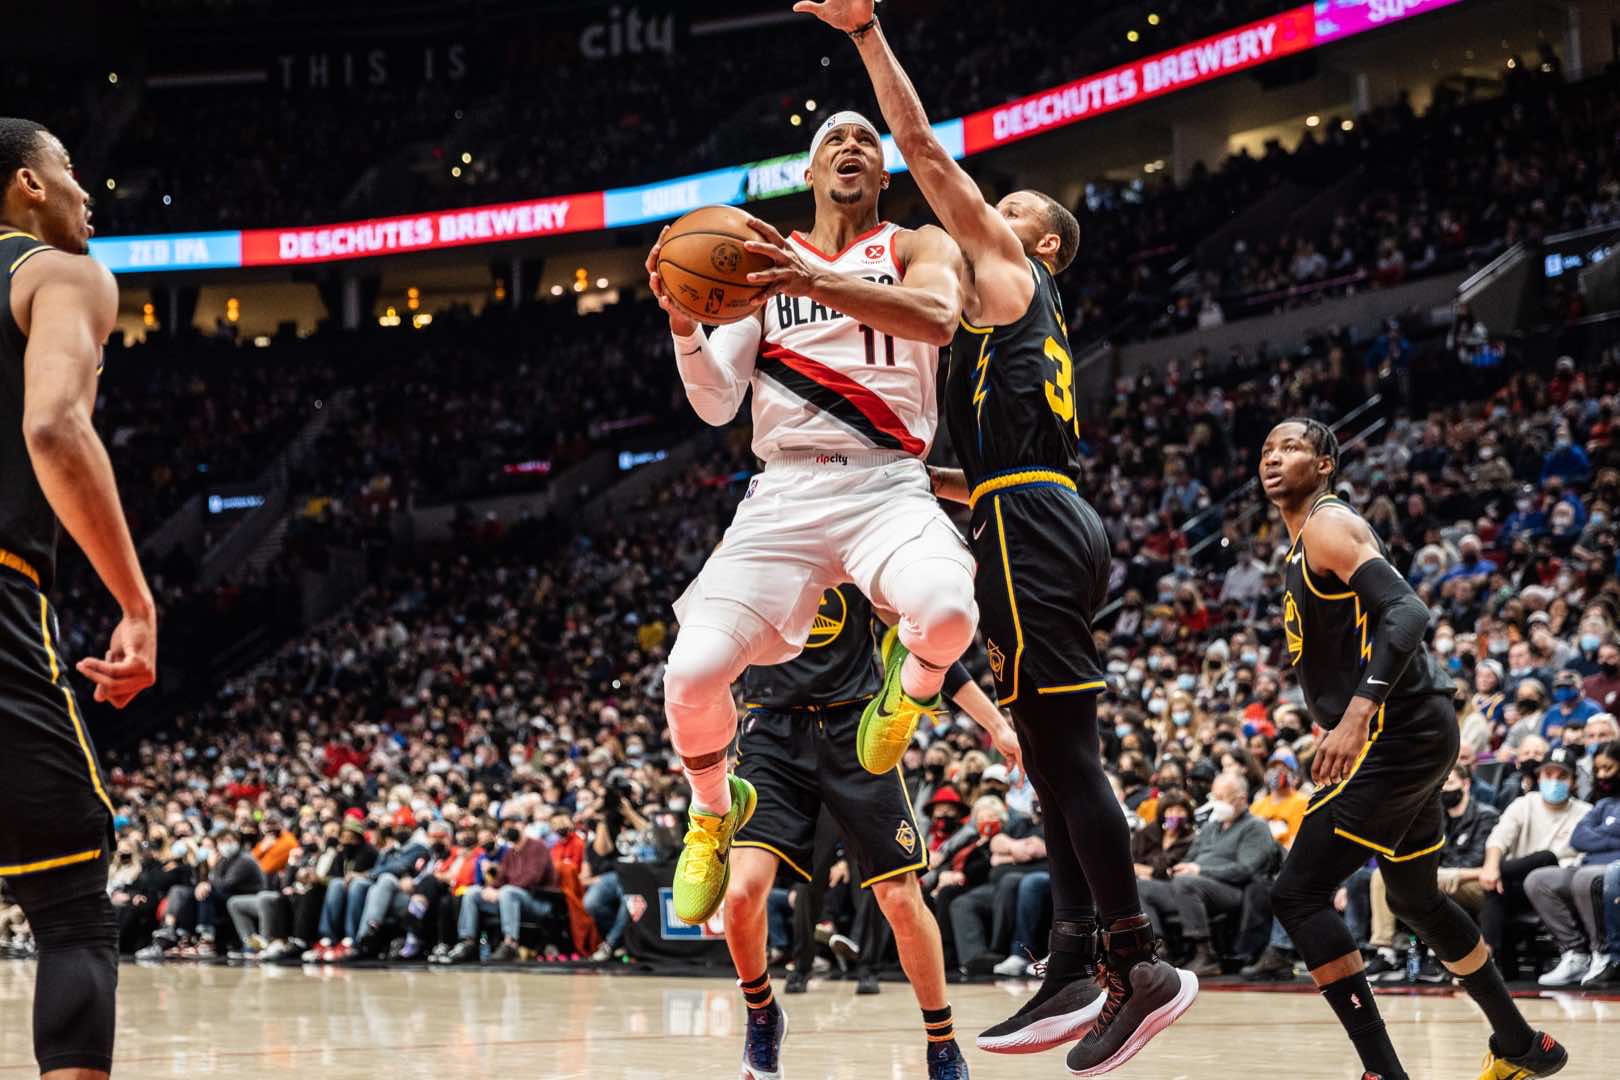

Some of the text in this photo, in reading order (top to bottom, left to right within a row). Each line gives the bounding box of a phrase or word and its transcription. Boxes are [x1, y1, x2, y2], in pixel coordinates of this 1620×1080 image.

[278, 43, 468, 91] THIS IS
[992, 22, 1277, 141] DESCHUTES BREWERY
[174, 238, 209, 263] IPA
[278, 200, 570, 260] DESCHUTES BREWERY
[859, 324, 896, 367] 11
[815, 453, 848, 466] ripcity
